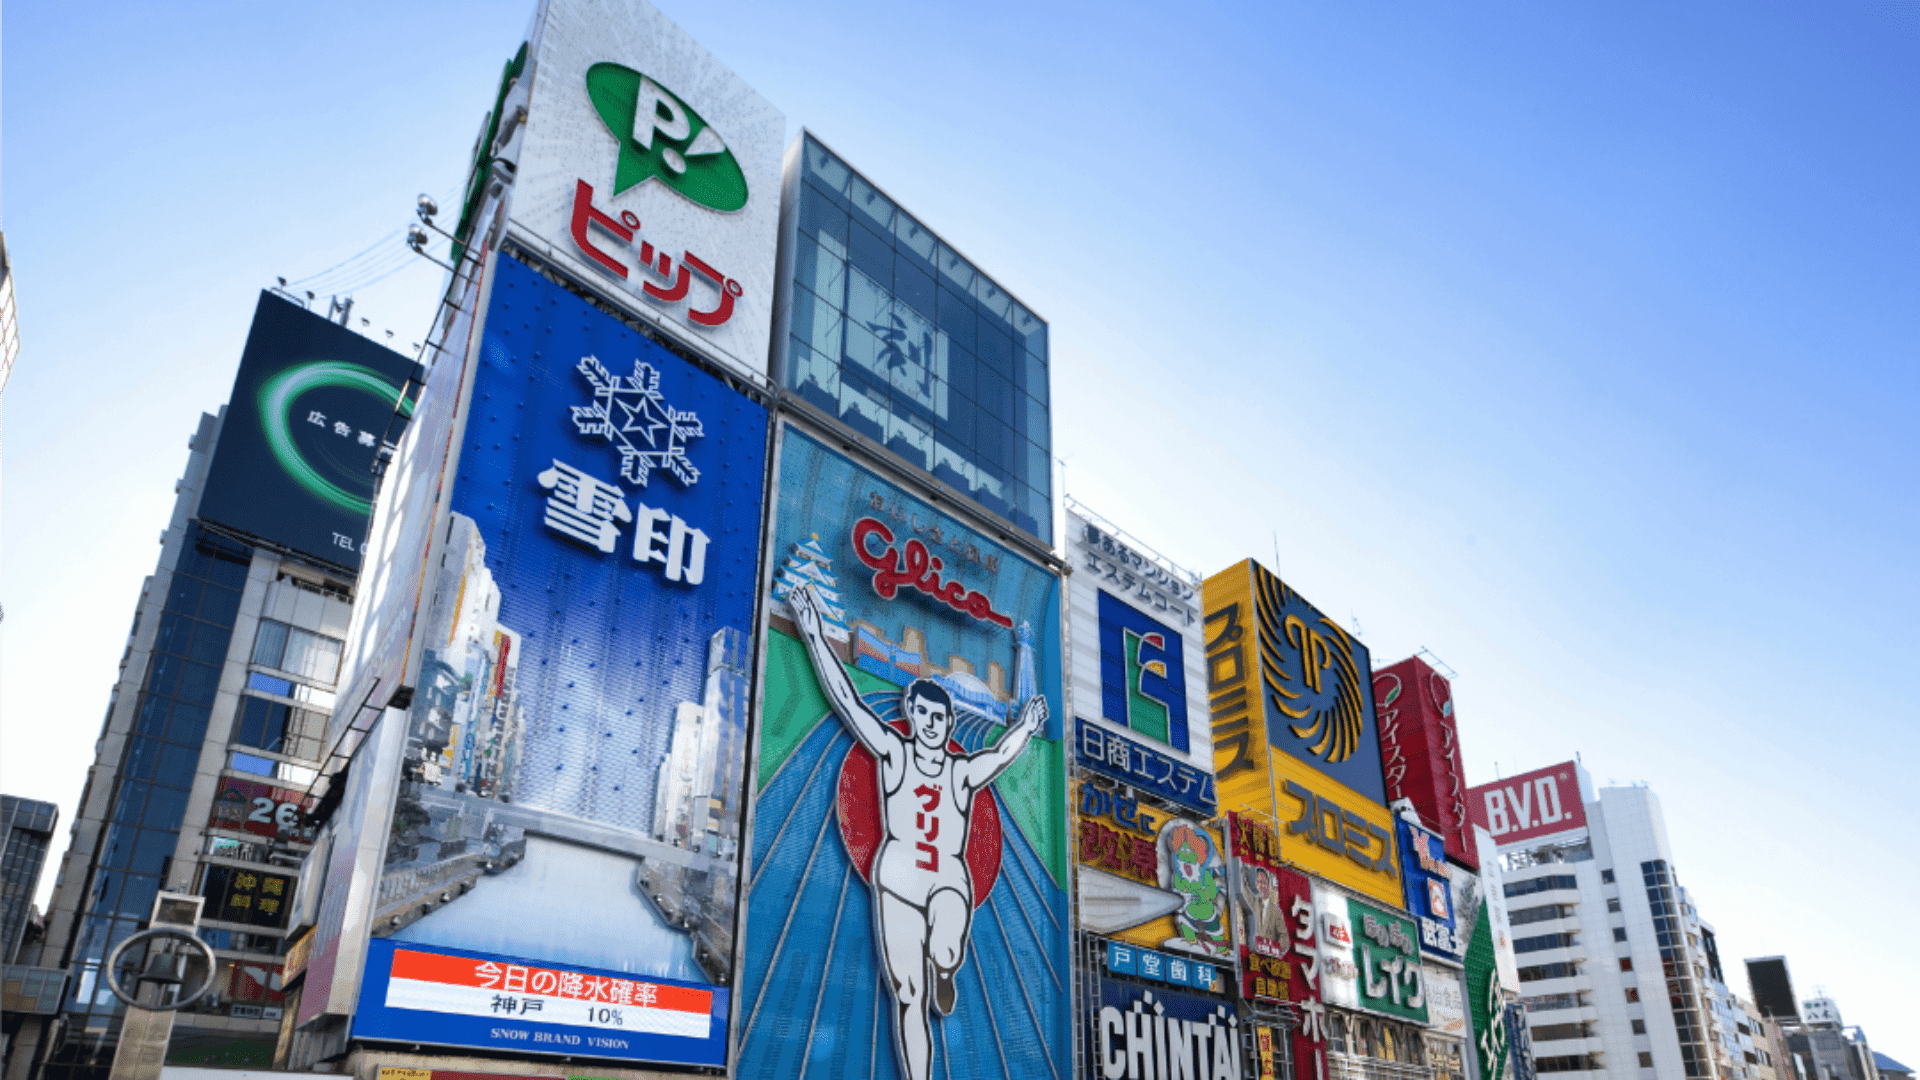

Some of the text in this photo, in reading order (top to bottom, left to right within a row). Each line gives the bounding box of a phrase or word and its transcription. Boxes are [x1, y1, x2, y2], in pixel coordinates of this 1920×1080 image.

[570, 178, 743, 326] ピップ
[332, 532, 355, 551] TEL
[537, 458, 711, 585] 雪印
[852, 517, 1014, 628] Glico
[1087, 551, 1195, 626] エステムコート
[1203, 601, 1255, 783] プロミス
[1082, 723, 1217, 806] 日商エステム
[913, 783, 943, 873] グリコ
[1286, 779, 1398, 877] プロミス
[1484, 775, 1573, 838] B.V.D.
[474, 961, 658, 1008] 今日の降水確率
[490, 994, 624, 1026] 神戸 10%
[1362, 943, 1425, 1008] レイク
[490, 1027, 630, 1050] SNOW BRAND VISION
[1100, 1003, 1242, 1080] CHINTAI
